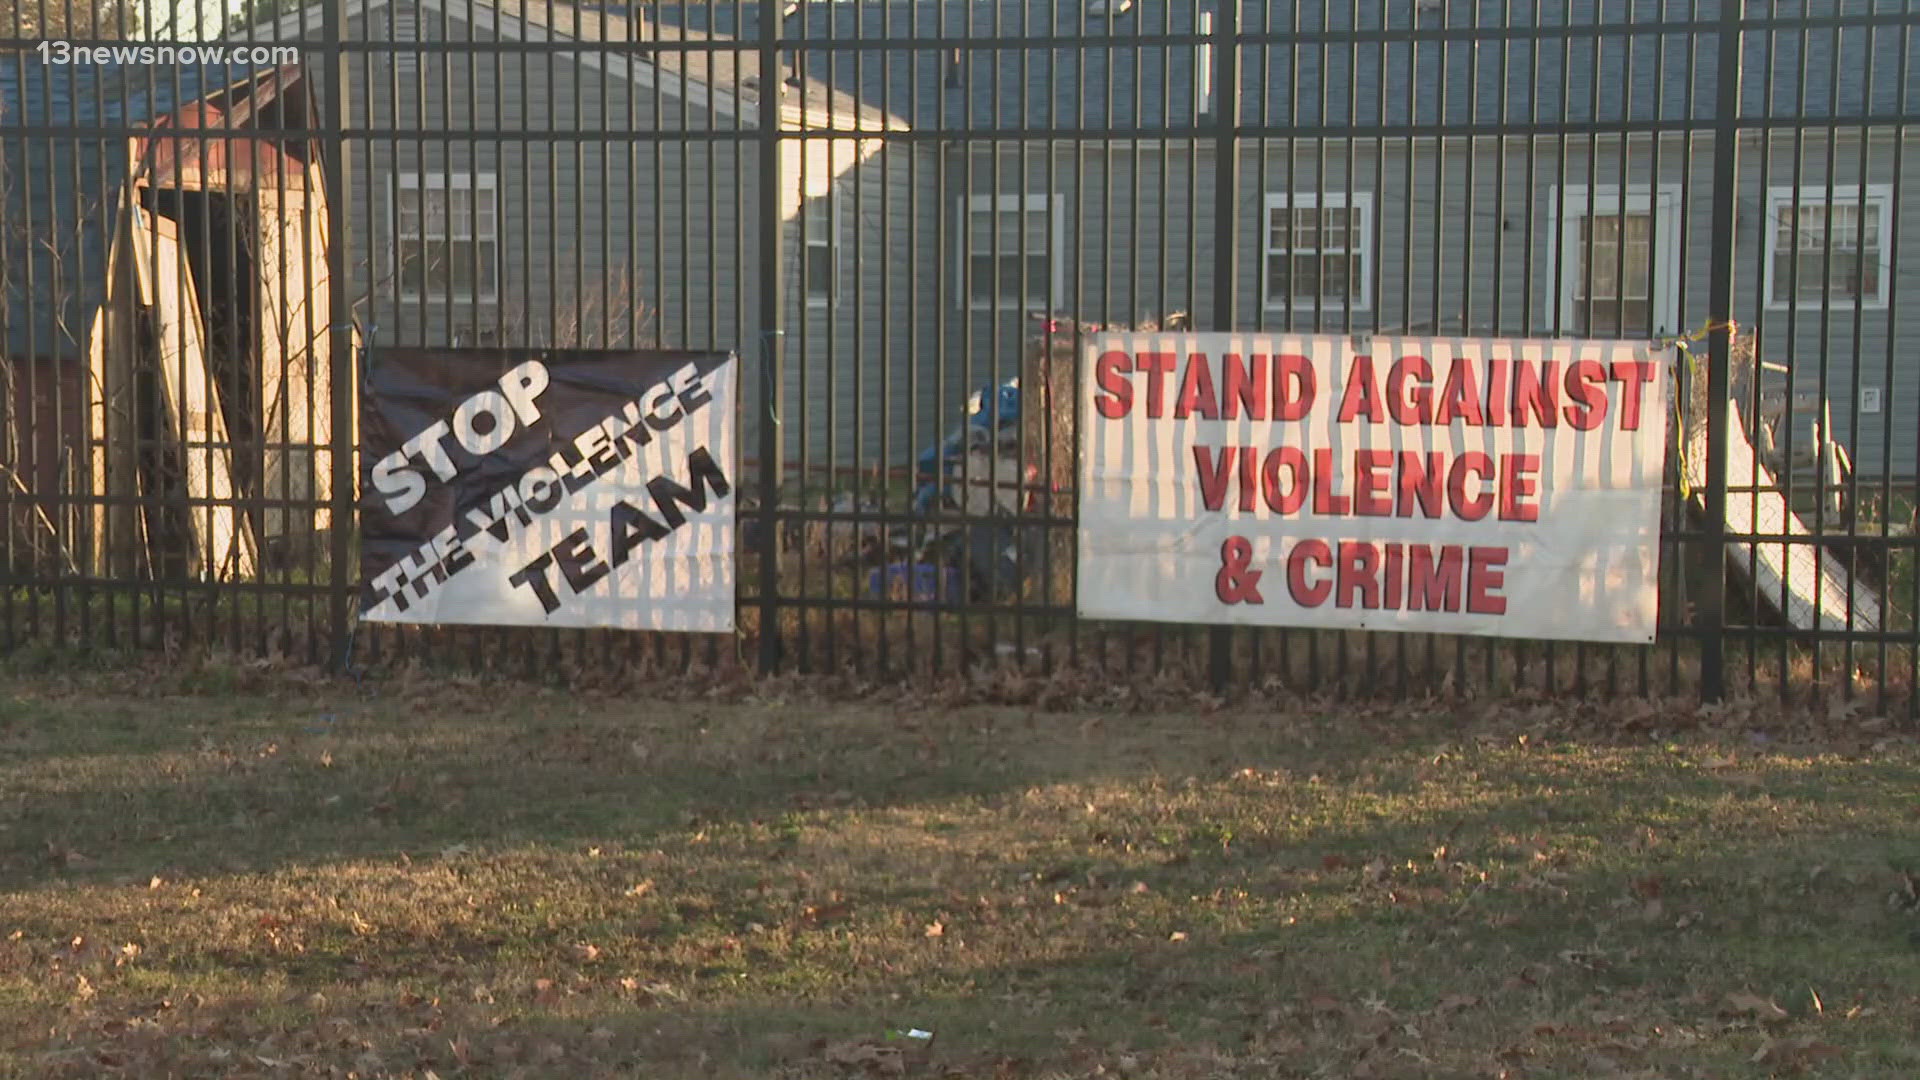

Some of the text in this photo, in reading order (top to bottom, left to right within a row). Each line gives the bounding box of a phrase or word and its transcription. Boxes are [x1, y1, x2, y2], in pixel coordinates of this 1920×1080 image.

[371, 360, 549, 516] STOP
[1094, 351, 1656, 431] STAND AGAINST
[370, 362, 712, 613] THE VIOLENCE
[509, 445, 731, 615] TEAM
[1193, 445, 1540, 522] VIOLENCE
[1215, 535, 1508, 615] & CRIME
